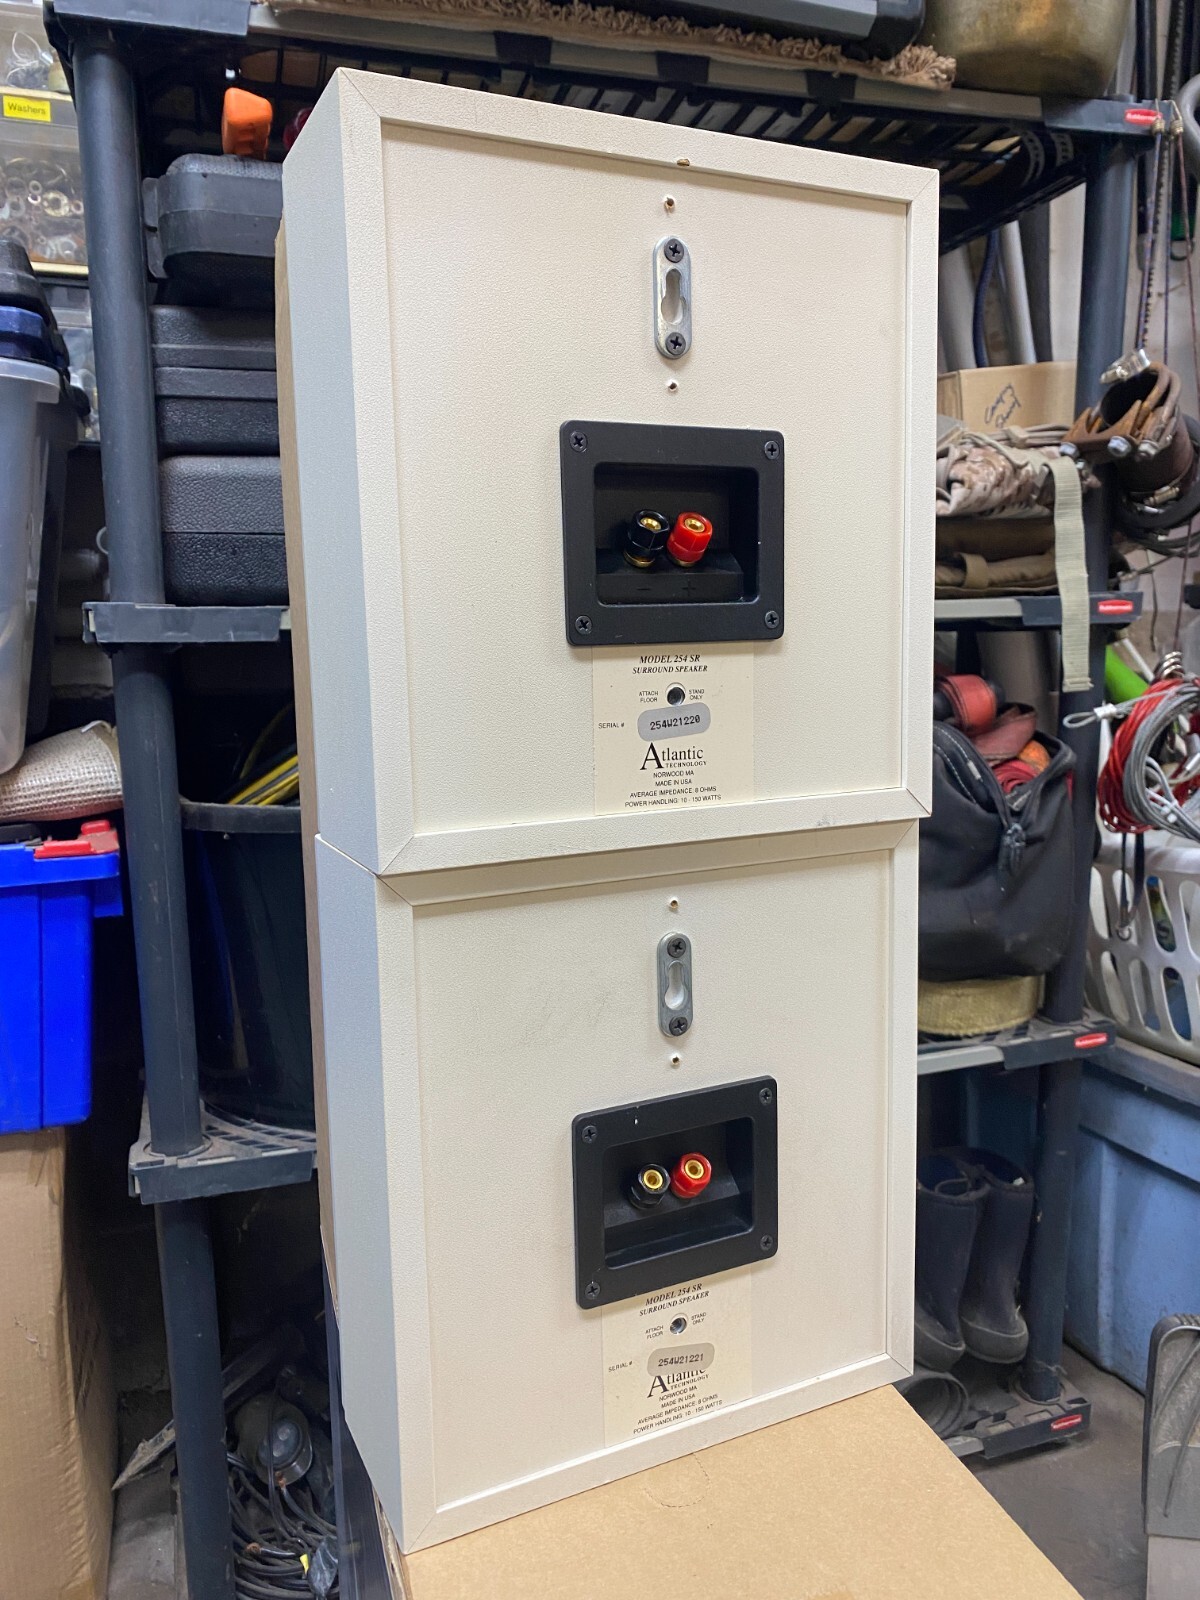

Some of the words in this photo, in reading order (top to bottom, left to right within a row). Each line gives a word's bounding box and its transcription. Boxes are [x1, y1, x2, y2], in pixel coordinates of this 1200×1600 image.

[8, 102, 46, 115] Washers
[640, 655, 672, 664] MODEL
[633, 666, 674, 674] SURROUND
[675, 665, 708, 673] SPEAKER
[650, 715, 700, 730] 254W21220
[640, 742, 703, 770] Atlantic
[630, 790, 657, 798] AVERAGE
[646, 1291, 676, 1306] MODEL
[678, 1286, 690, 1296] 254
[692, 1283, 702, 1292] SR
[640, 1301, 677, 1316] SURROUND
[679, 1291, 709, 1304] SPEAKER
[691, 1312, 706, 1320] STAND
[645, 1325, 663, 1334] ATTACH
[658, 1353, 703, 1366] 254W21221
[609, 1363, 628, 1372] SERIAL
[671, 1374, 709, 1390] TECHNOLOGY
[659, 1388, 687, 1401] NORWOOD
[638, 1412, 663, 1425] AVERAGE
[702, 1394, 718, 1402] OHMS
[661, 1399, 676, 1408] MADE
[633, 1423, 654, 1434] POWER
[705, 1400, 722, 1409] WATTS
